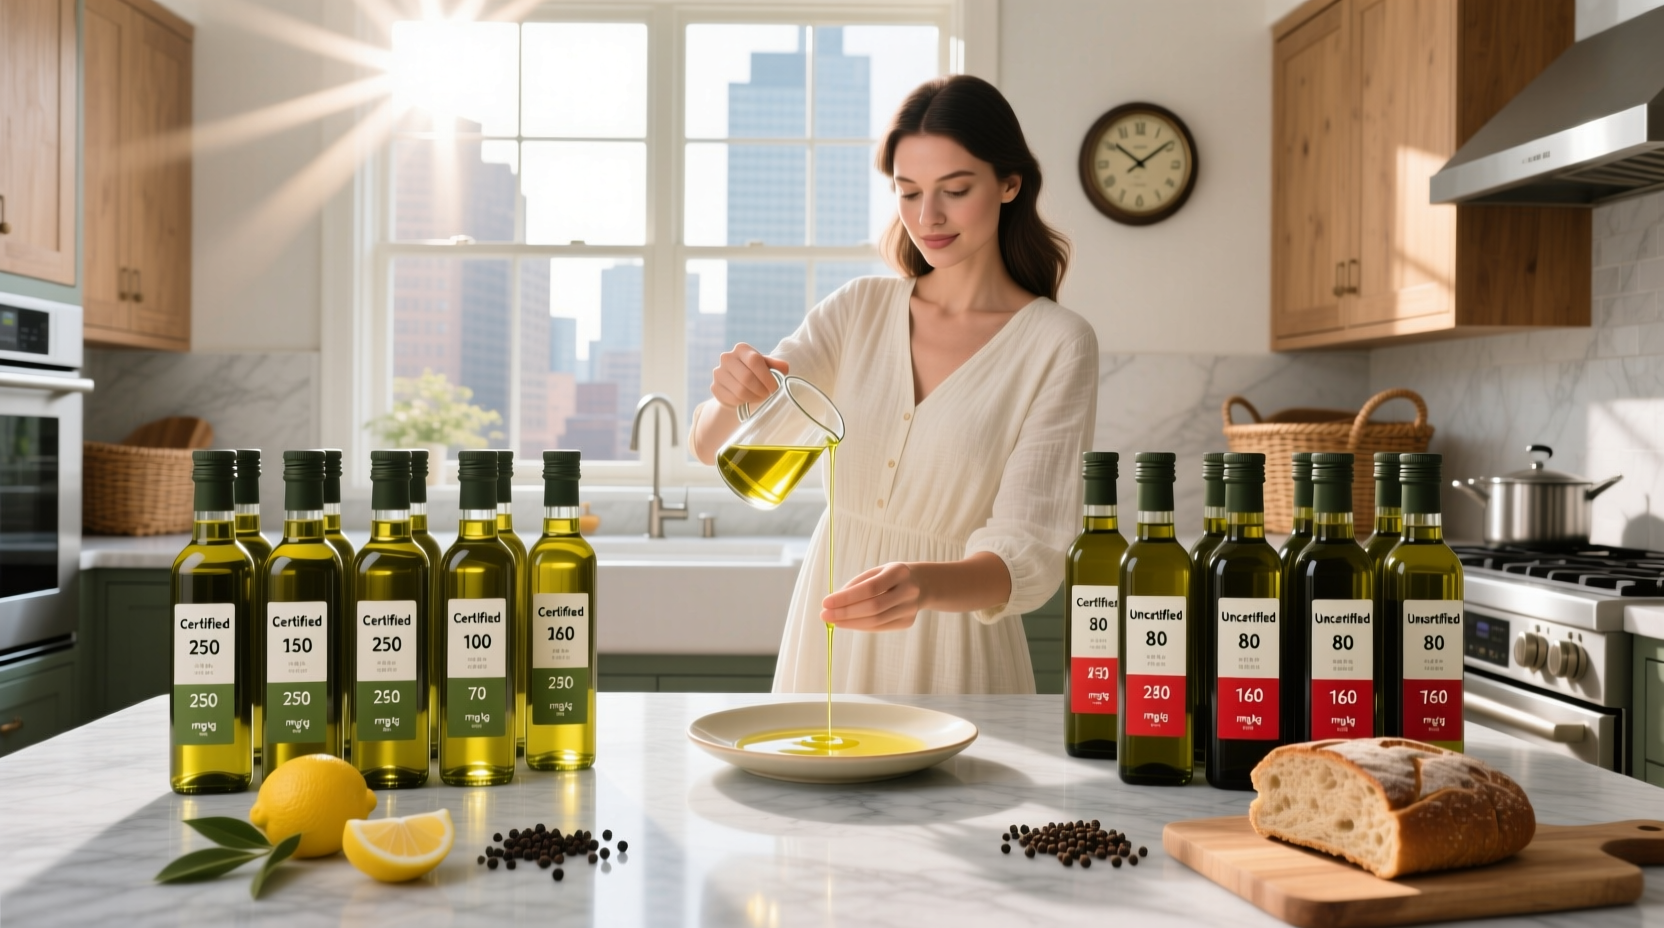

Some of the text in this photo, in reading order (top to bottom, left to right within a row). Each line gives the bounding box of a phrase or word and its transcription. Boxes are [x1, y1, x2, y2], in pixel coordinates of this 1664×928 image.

[180, 618, 229, 629] Certified
[273, 615, 322, 627] Certified
[363, 614, 411, 626] Certified
[1089, 617, 1107, 631] 80
[282, 638, 312, 653] 150
[372, 636, 402, 652] 250
[464, 634, 491, 649] 100
[1146, 631, 1167, 646] 80
[1238, 633, 1260, 649] 80
[1332, 635, 1354, 650] 80
[1424, 635, 1445, 650] 80
[189, 639, 220, 655] 250
[189, 693, 218, 708] 250
[283, 691, 311, 706] 250
[373, 689, 400, 704] 250
[468, 687, 486, 700] 70
[1236, 688, 1263, 703] 160
[1329, 690, 1357, 705] 160
